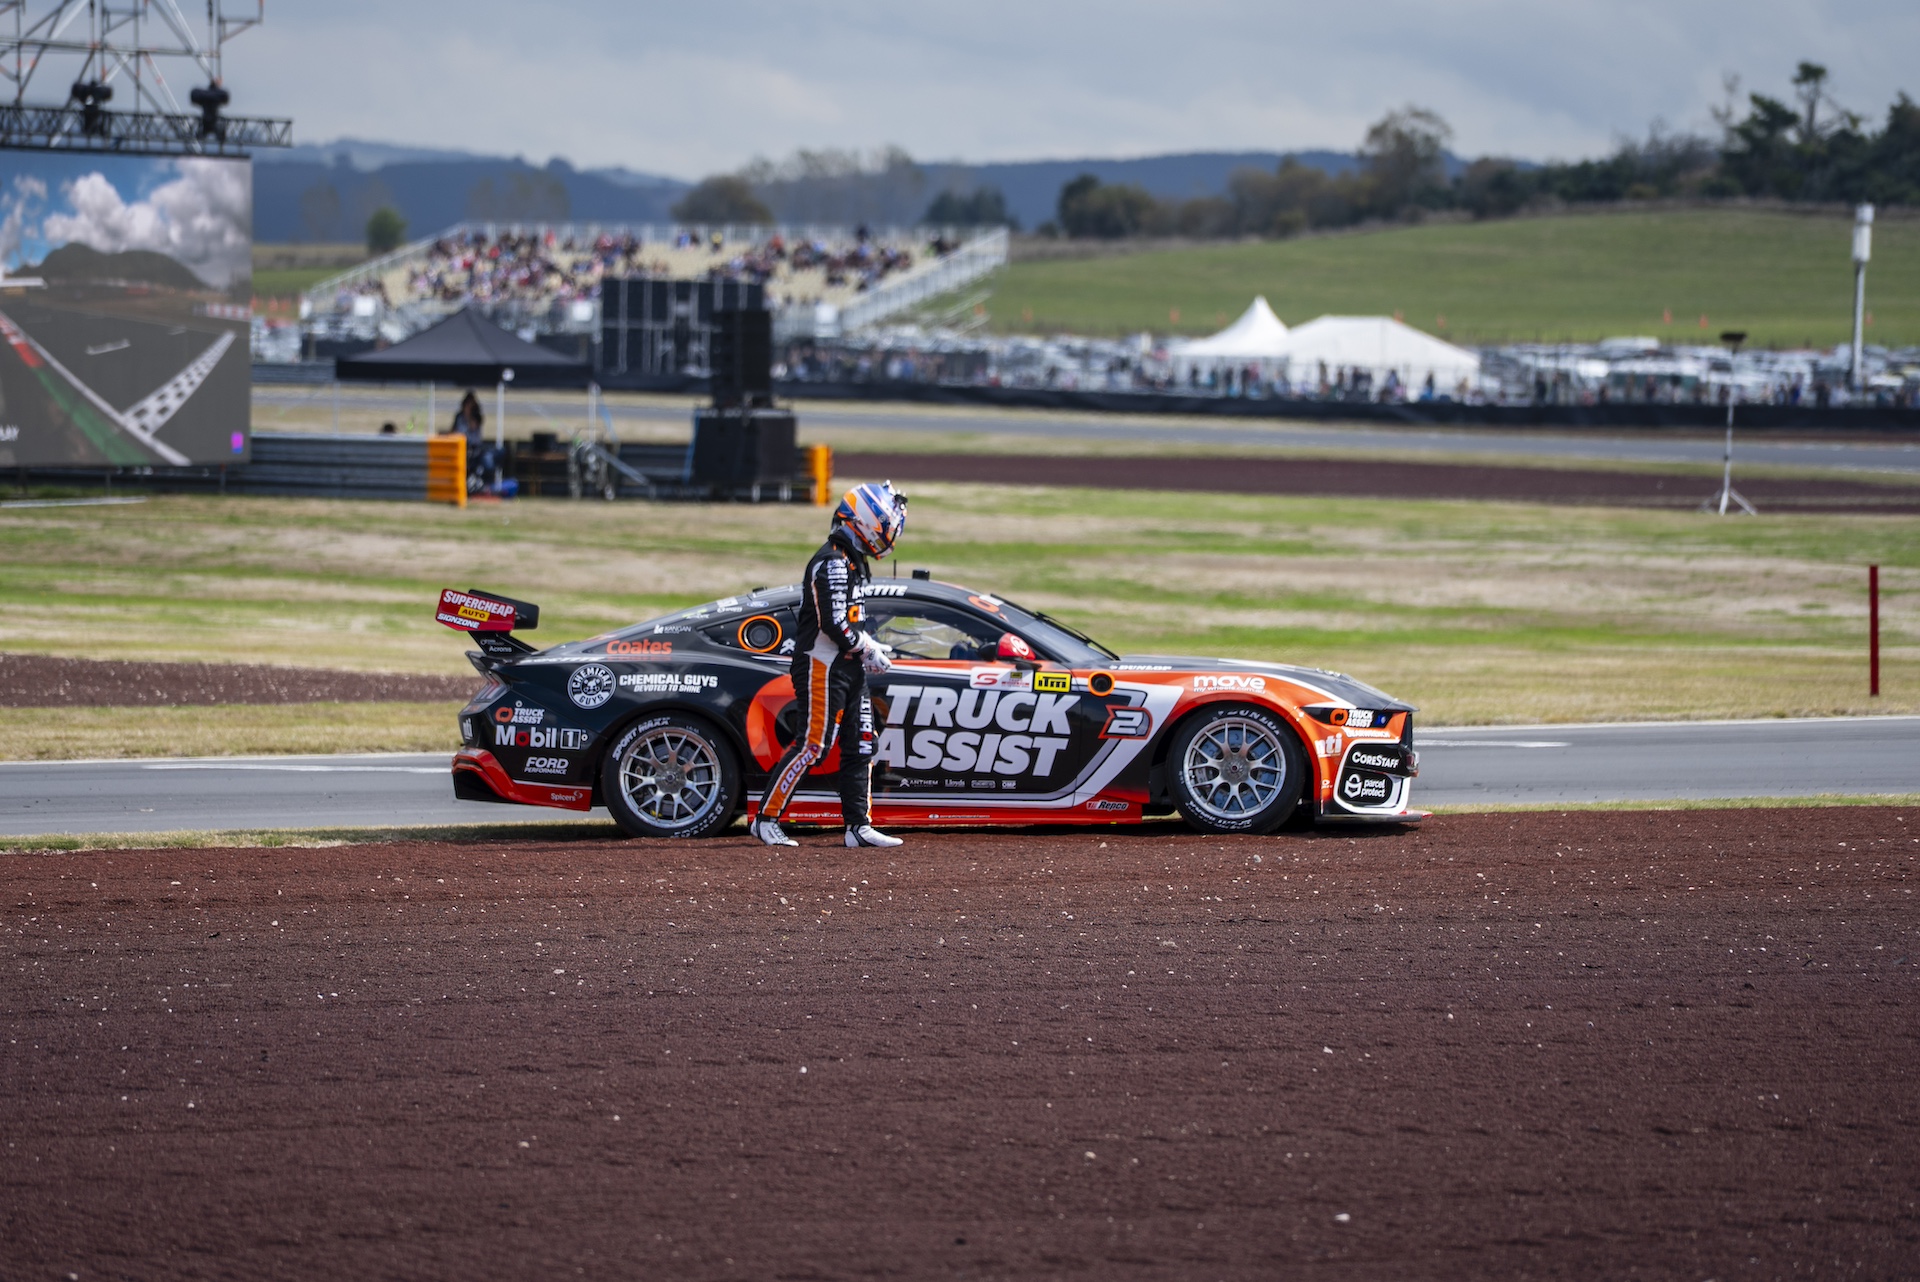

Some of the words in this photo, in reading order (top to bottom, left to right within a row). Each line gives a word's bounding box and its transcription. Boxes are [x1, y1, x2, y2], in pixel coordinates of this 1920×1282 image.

[443, 590, 514, 618] SUPERCHEAP
[461, 609, 486, 619] AUTO
[437, 613, 480, 629] SIGNZONE
[607, 639, 673, 654] Coates
[572, 666, 612, 689] CHEMICAL
[618, 673, 682, 686] CHEMICAL
[684, 674, 718, 688] GUYS
[1193, 675, 1266, 690] move
[633, 684, 668, 693] DEVOTED
[678, 685, 702, 694] SHINE
[578, 694, 604, 705] GUYS
[513, 708, 545, 717] TRUCK
[886, 685, 1081, 735] TRUCK
[1348, 709, 1375, 719] TRUCK
[510, 715, 544, 724] ASSIST
[1107, 710, 1144, 734] 2
[1345, 718, 1373, 728] ASSIST
[495, 725, 558, 748] Mobil
[859, 712, 874, 755] Mobil
[612, 728, 637, 761] SPORT
[876, 727, 1069, 777] ASSIST
[525, 756, 569, 769] FORD
[524, 767, 567, 775] PERFORMANCE
[1364, 779, 1386, 789] parcel
[550, 792, 576, 801] Spicers
[1361, 787, 1385, 798] protect
[1098, 801, 1127, 810] Repco
